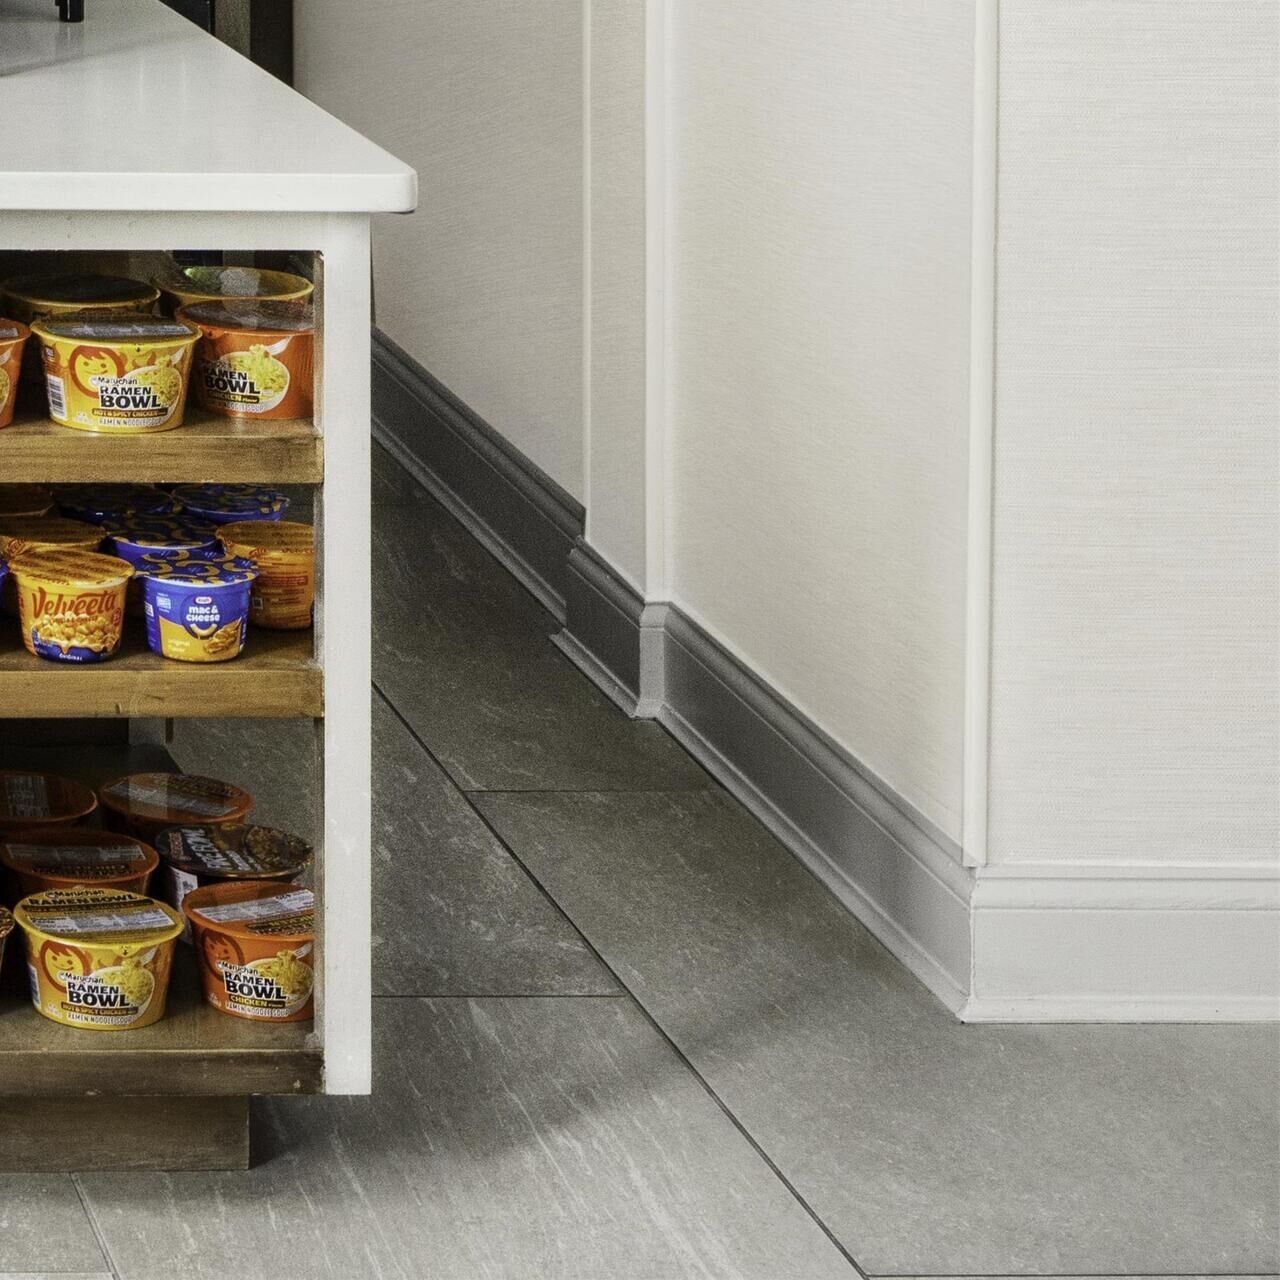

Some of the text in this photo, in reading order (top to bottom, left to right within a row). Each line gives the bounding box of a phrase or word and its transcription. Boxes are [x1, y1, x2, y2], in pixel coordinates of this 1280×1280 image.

[98, 377, 138, 386] Maruchan
[205, 379, 261, 395] BOWL
[100, 386, 152, 396] RAMEN
[100, 395, 161, 409] BOWL
[32, 587, 117, 619] Velveeta
[188, 605, 218, 614] mac &
[28, 897, 89, 906] RAMEN
[65, 972, 104, 984] Maruchan
[224, 971, 275, 986] RAMEN
[68, 982, 120, 994] RAMEN
[226, 981, 288, 1000] BOWL
[69, 991, 131, 1007] BOWL
[230, 995, 269, 1007] CHICKEN
